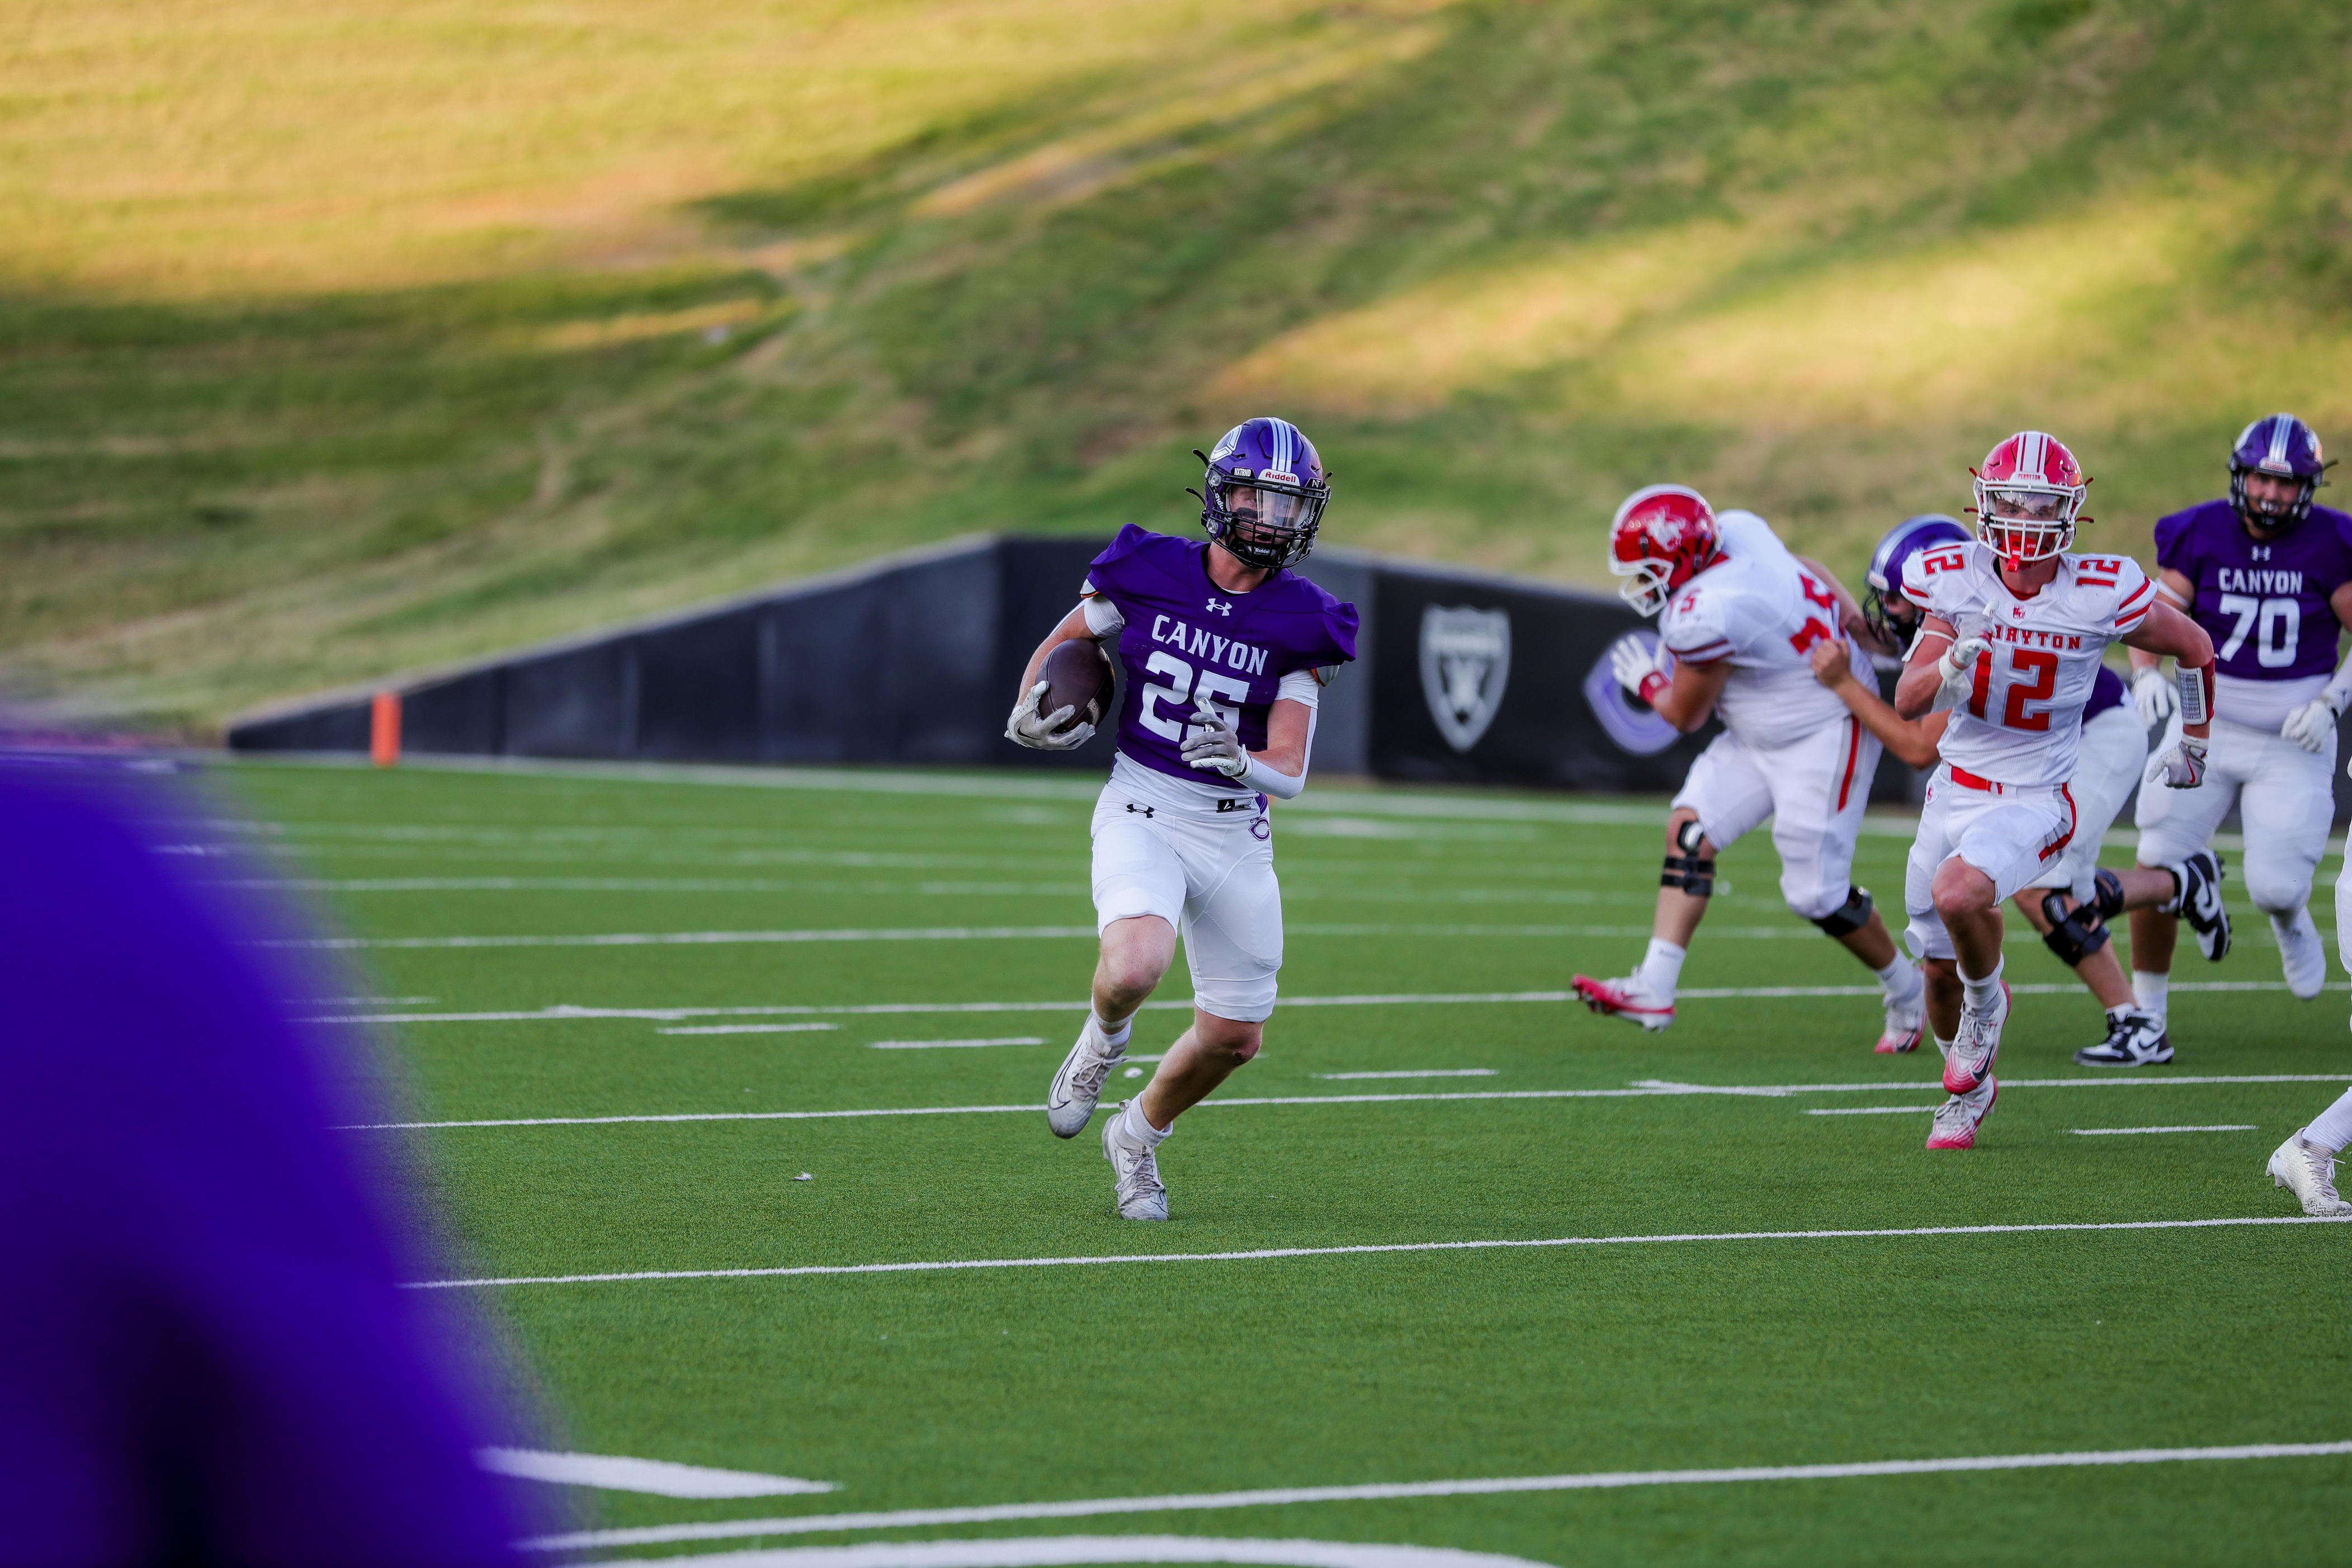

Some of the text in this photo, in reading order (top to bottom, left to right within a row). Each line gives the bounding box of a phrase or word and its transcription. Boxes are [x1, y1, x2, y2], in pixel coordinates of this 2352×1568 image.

[1234, 467, 1251, 477] NXTRND
[1265, 471, 1296, 483] Riddell
[1922, 545, 1964, 577] 12
[2075, 559, 2121, 588] 12
[2218, 568, 2303, 594] CANYON
[1151, 614, 1268, 676] CANYON
[2219, 593, 2300, 668] 70
[1139, 650, 1250, 743] 25
[1967, 648, 2060, 731] 12
